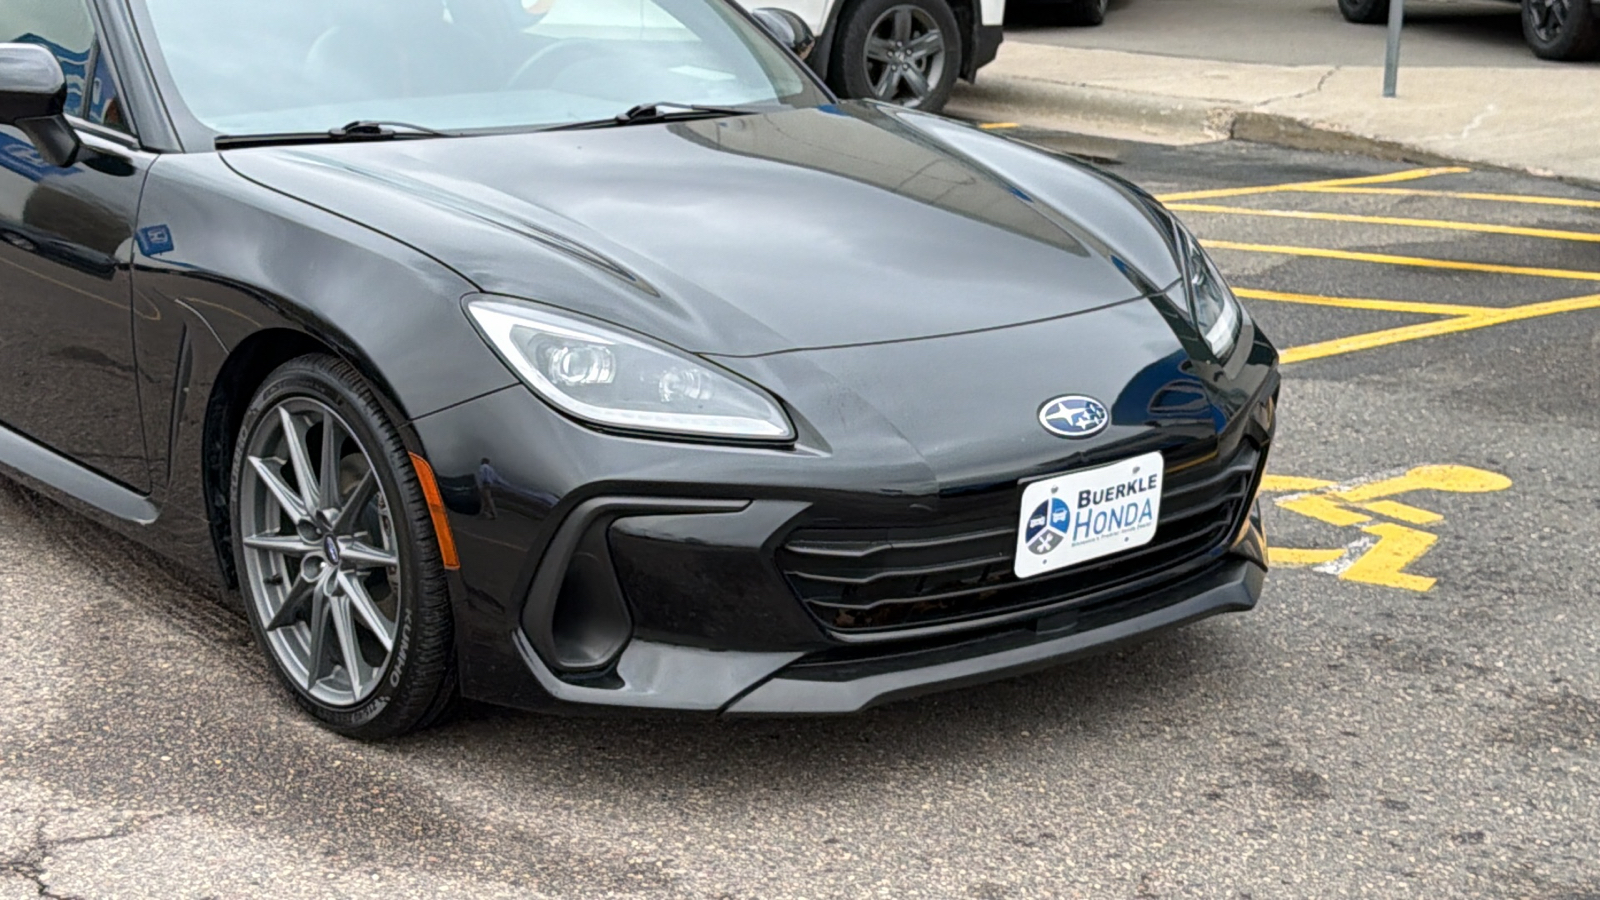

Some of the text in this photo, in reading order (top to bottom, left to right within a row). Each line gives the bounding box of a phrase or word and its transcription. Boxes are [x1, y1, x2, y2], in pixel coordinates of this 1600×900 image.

[1077, 473, 1157, 509] BUERKLE
[1072, 498, 1152, 541] HONDA
[390, 608, 413, 688] KUMHO
